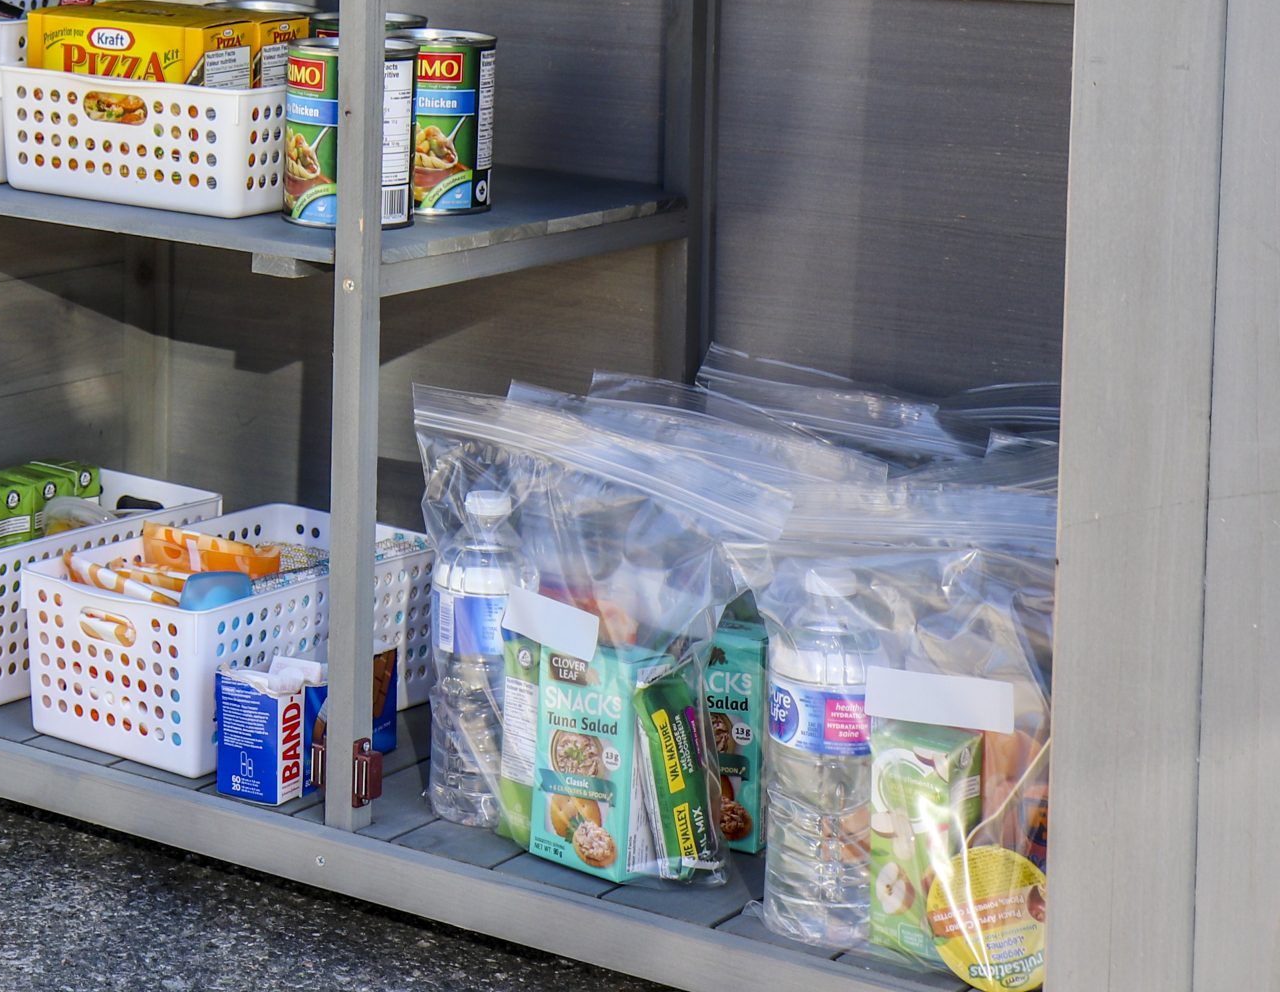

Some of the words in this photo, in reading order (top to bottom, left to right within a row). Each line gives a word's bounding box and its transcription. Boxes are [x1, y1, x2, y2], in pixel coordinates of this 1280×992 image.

[97, 32, 125, 47] Kraft
[217, 35, 242, 49] PIZZA
[273, 29, 297, 44] PIZZA
[60, 43, 166, 83] PIZZA
[384, 63, 398, 71] acts
[418, 59, 459, 78] IMO
[288, 63, 321, 85] RIMO
[385, 71, 400, 79] ritive
[292, 102, 320, 118] Chicken
[418, 96, 458, 109] Chicken
[552, 656, 586, 672] CLOVER
[559, 668, 580, 681] LEAF
[702, 670, 753, 696] ACKS
[707, 695, 749, 712] Salad
[770, 702, 786, 722] Life
[547, 711, 577, 729] Tuna
[581, 717, 618, 736] Salad
[282, 695, 301, 784] BAND-
[659, 721, 676, 761] NATURE
[838, 729, 860, 738] saine
[231, 774, 241, 784] 60
[669, 763, 680, 781] VAL
[231, 783, 241, 792] 20
[565, 776, 589, 788] Classic
[676, 809, 691, 844] VALLEY
[692, 806, 705, 833] MIX
[534, 842, 543, 850] NET
[970, 950, 1044, 980] ruitsations
